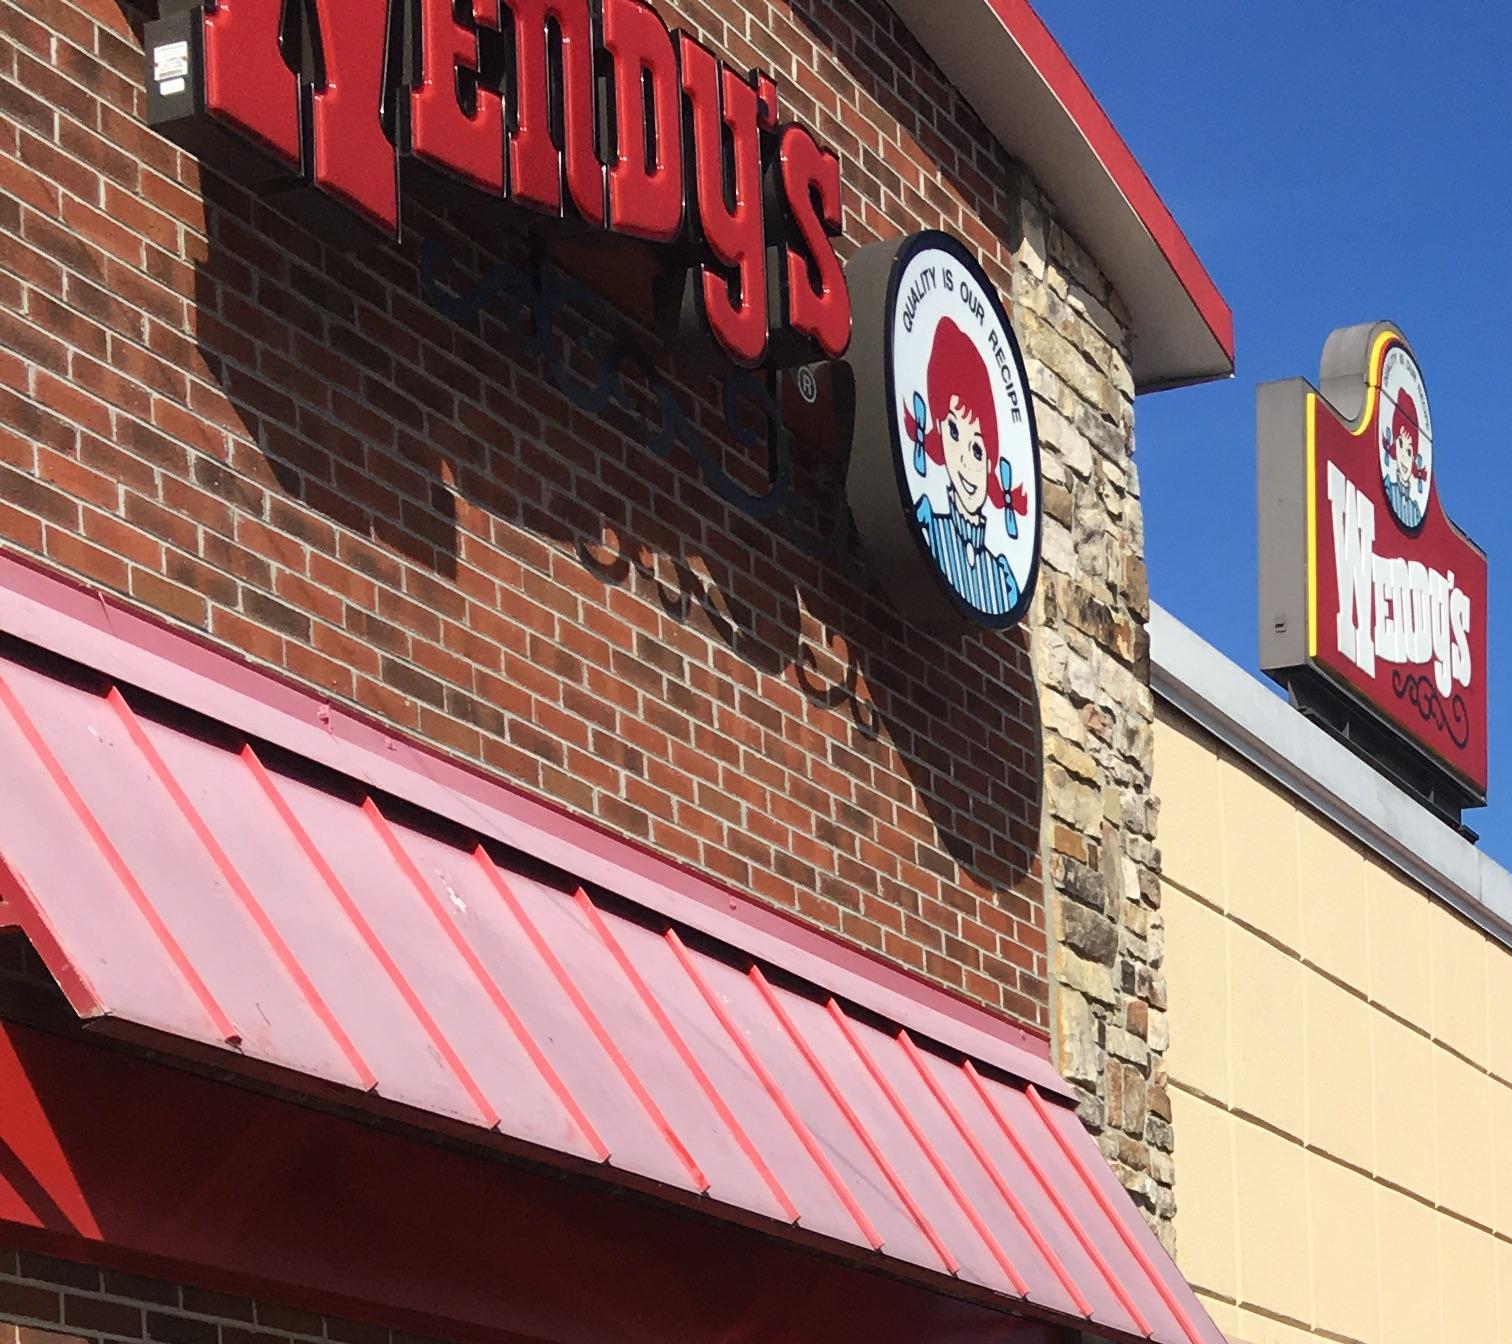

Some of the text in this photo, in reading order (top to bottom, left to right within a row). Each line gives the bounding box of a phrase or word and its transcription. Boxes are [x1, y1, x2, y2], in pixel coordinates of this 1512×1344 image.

[903, 266, 1022, 424] QUALITY IS OUR RECIPE
